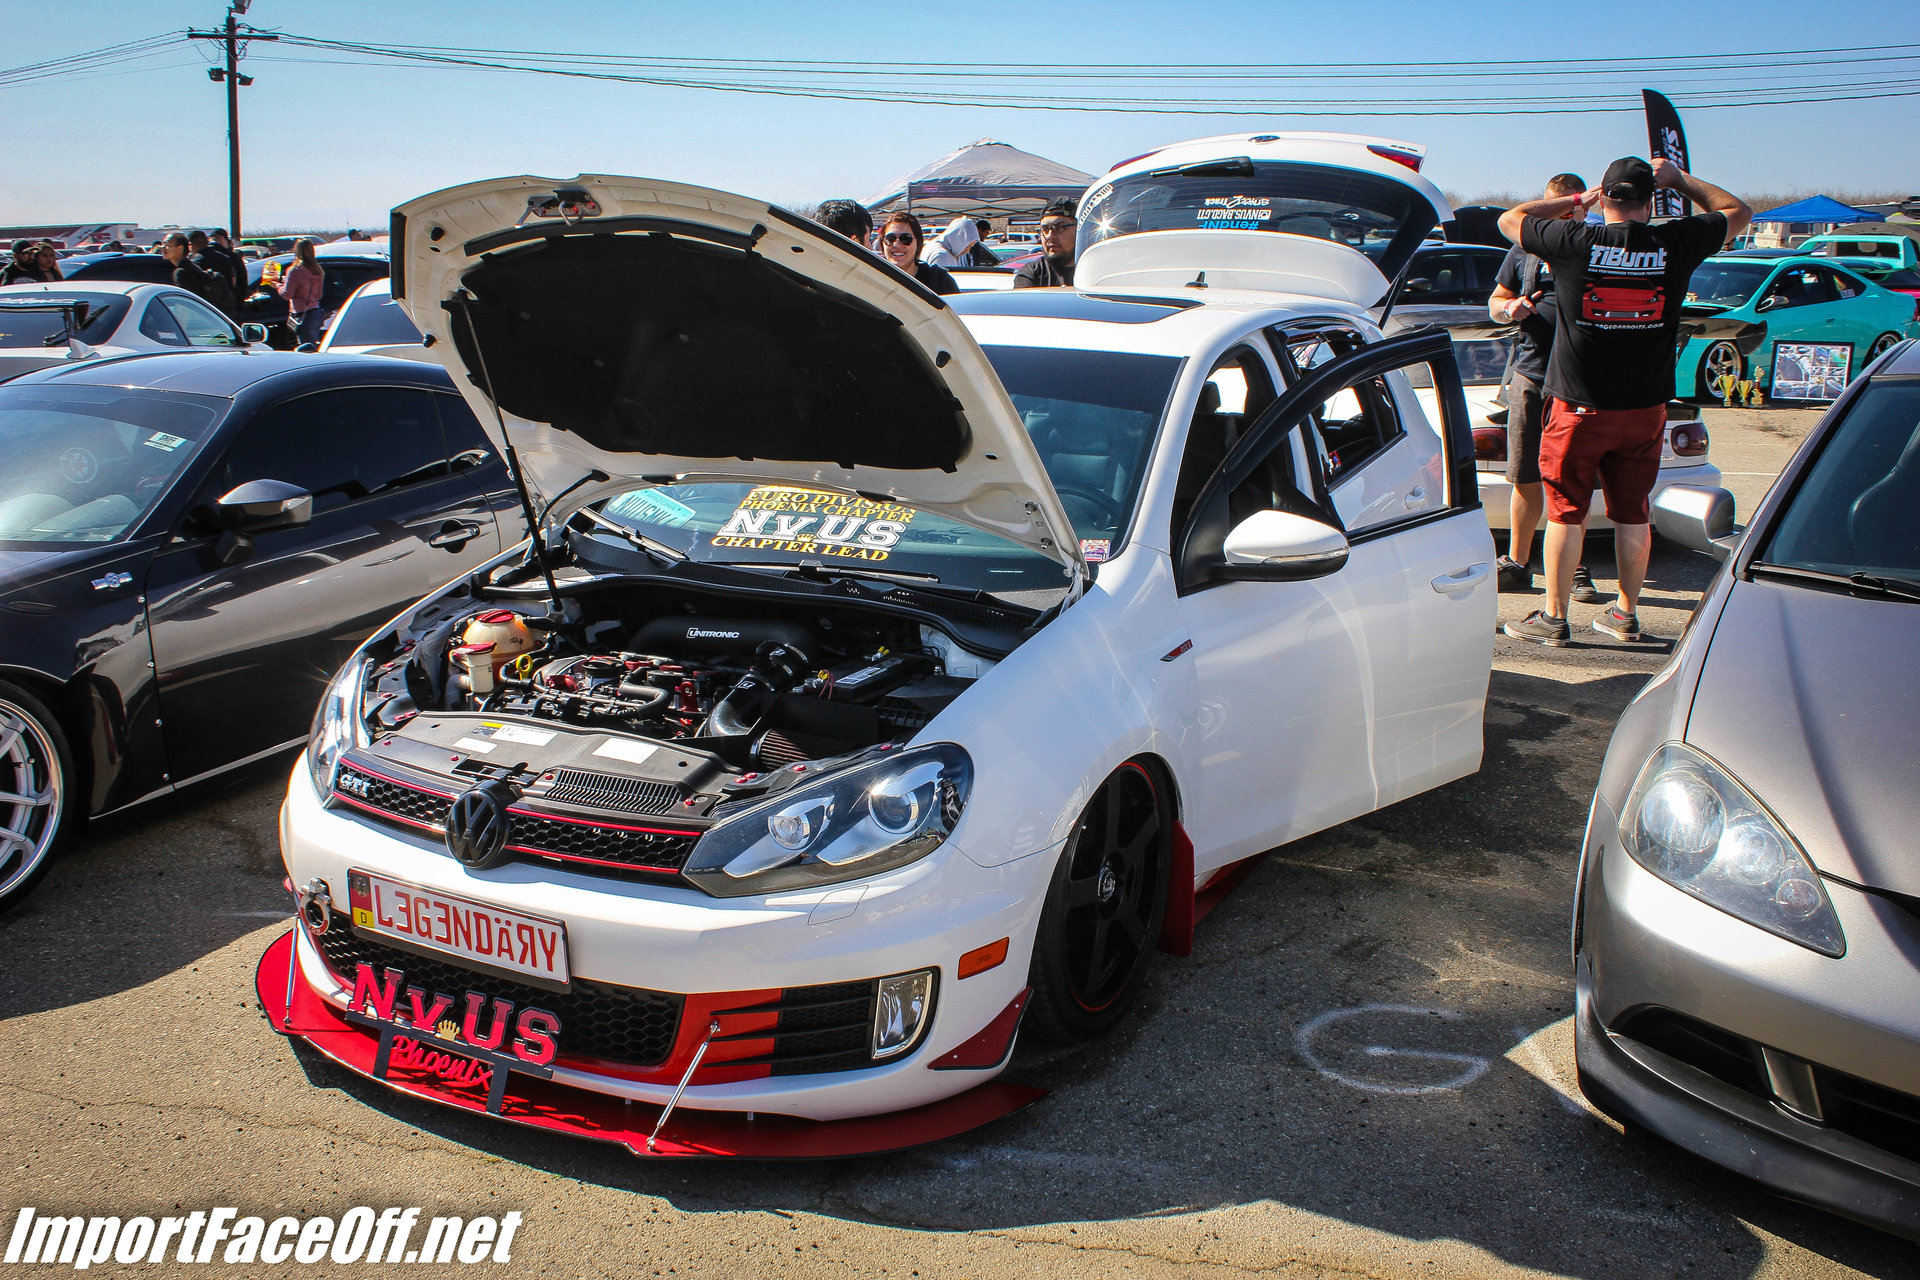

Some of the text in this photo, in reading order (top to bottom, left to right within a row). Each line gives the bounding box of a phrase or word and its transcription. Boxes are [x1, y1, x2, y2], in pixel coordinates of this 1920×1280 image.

[745, 491, 809, 503] EURO
[737, 500, 914, 524] PHOENIX CHAPTER
[711, 536, 891, 562] CHAPTER LEAD
[340, 774, 371, 798] GTI
[392, 1034, 494, 1092] Phoenix
